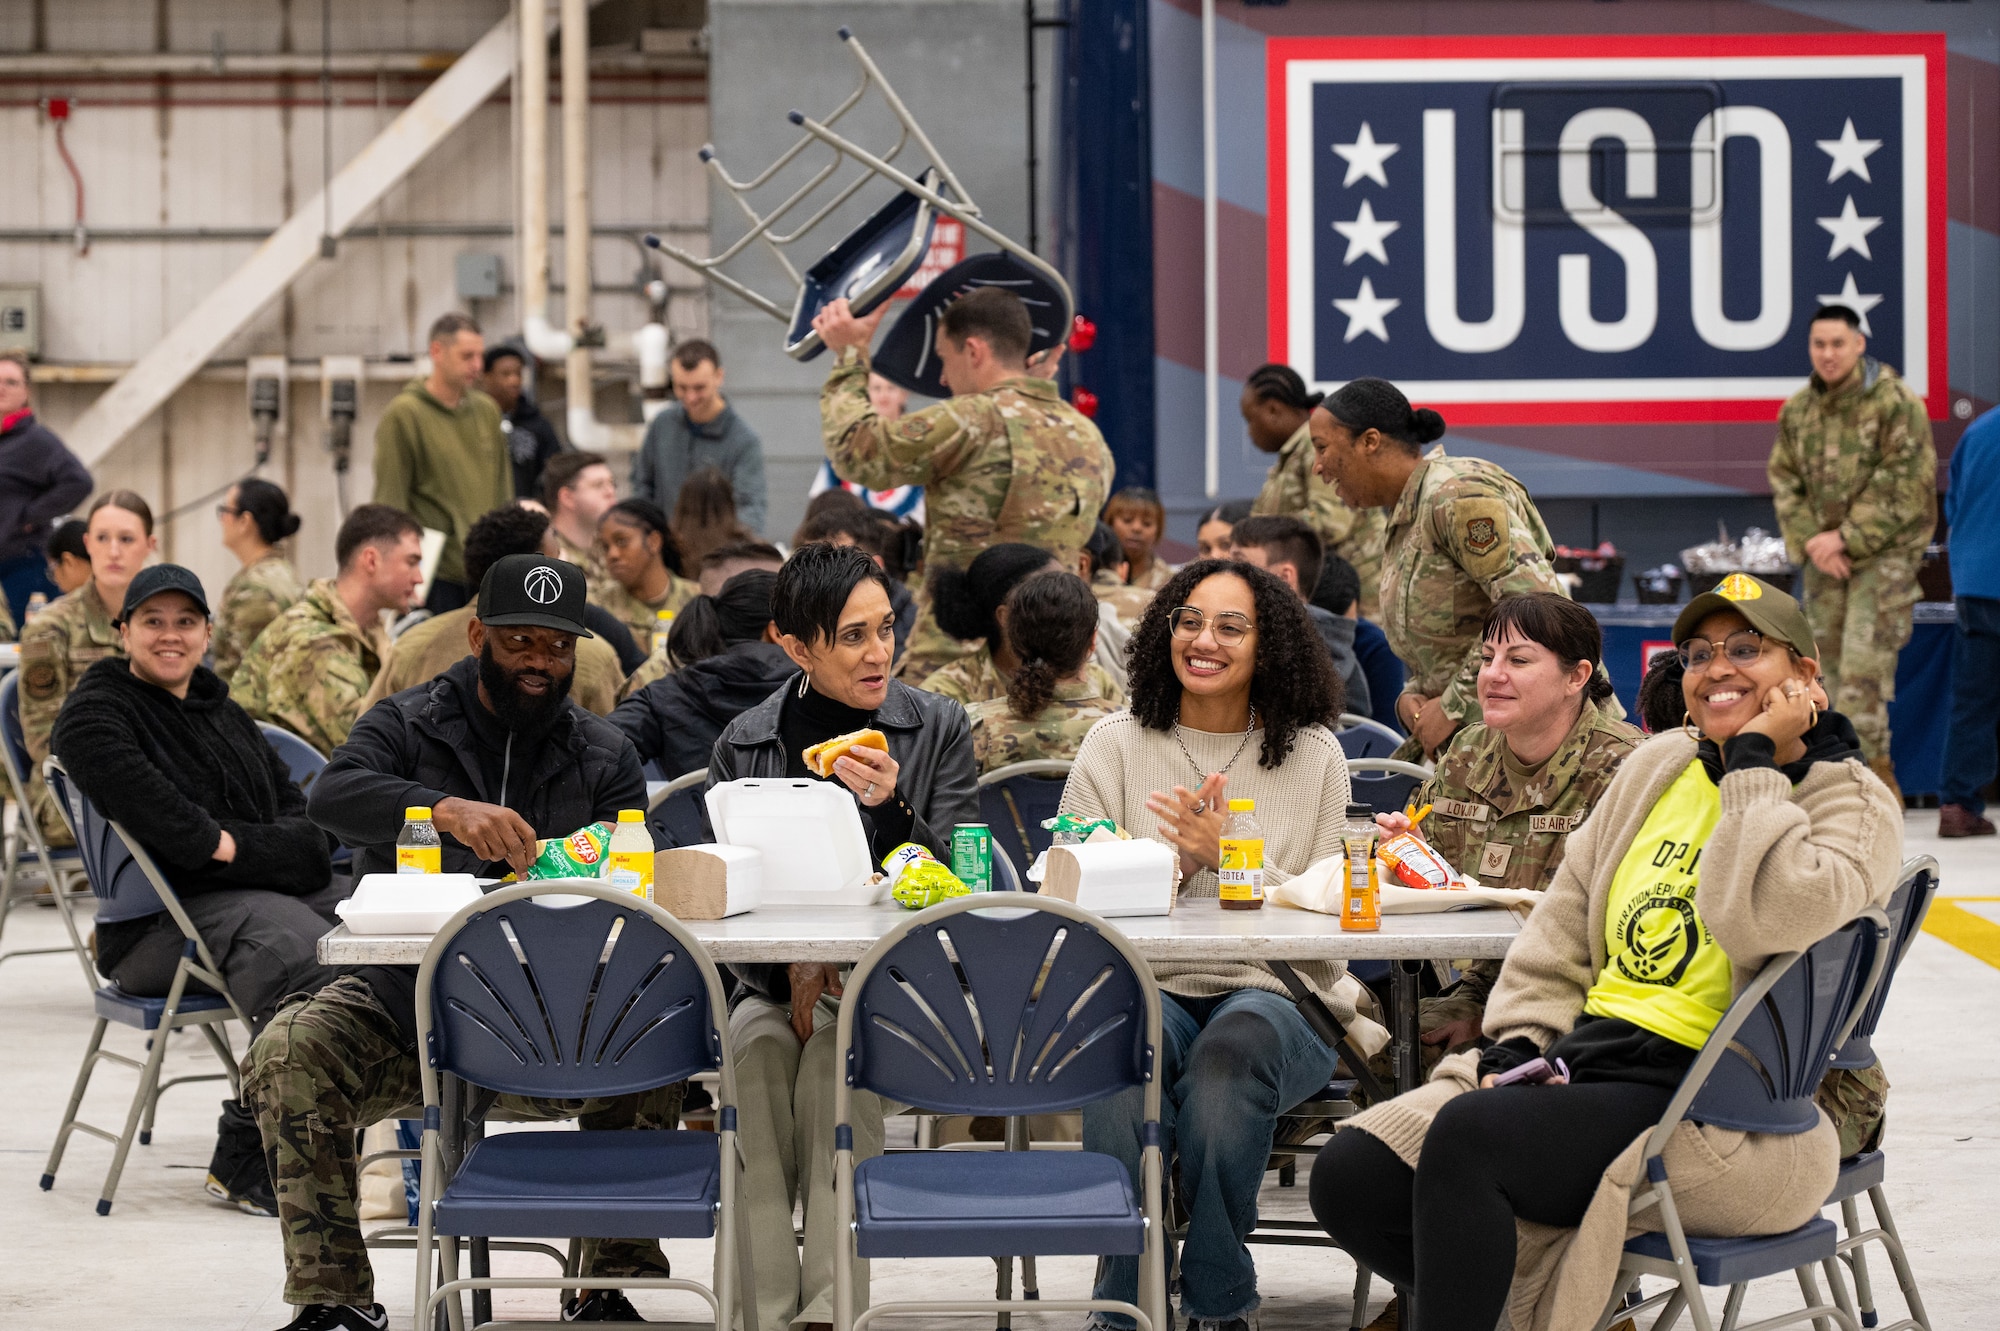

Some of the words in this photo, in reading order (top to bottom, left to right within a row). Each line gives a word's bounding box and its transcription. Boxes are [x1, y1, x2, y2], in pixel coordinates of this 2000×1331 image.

[1423, 105, 1792, 354] USO
[1548, 817, 1565, 831] AIR
[1231, 871, 1245, 881] TEA
[1617, 888, 1651, 940] OPERATION
